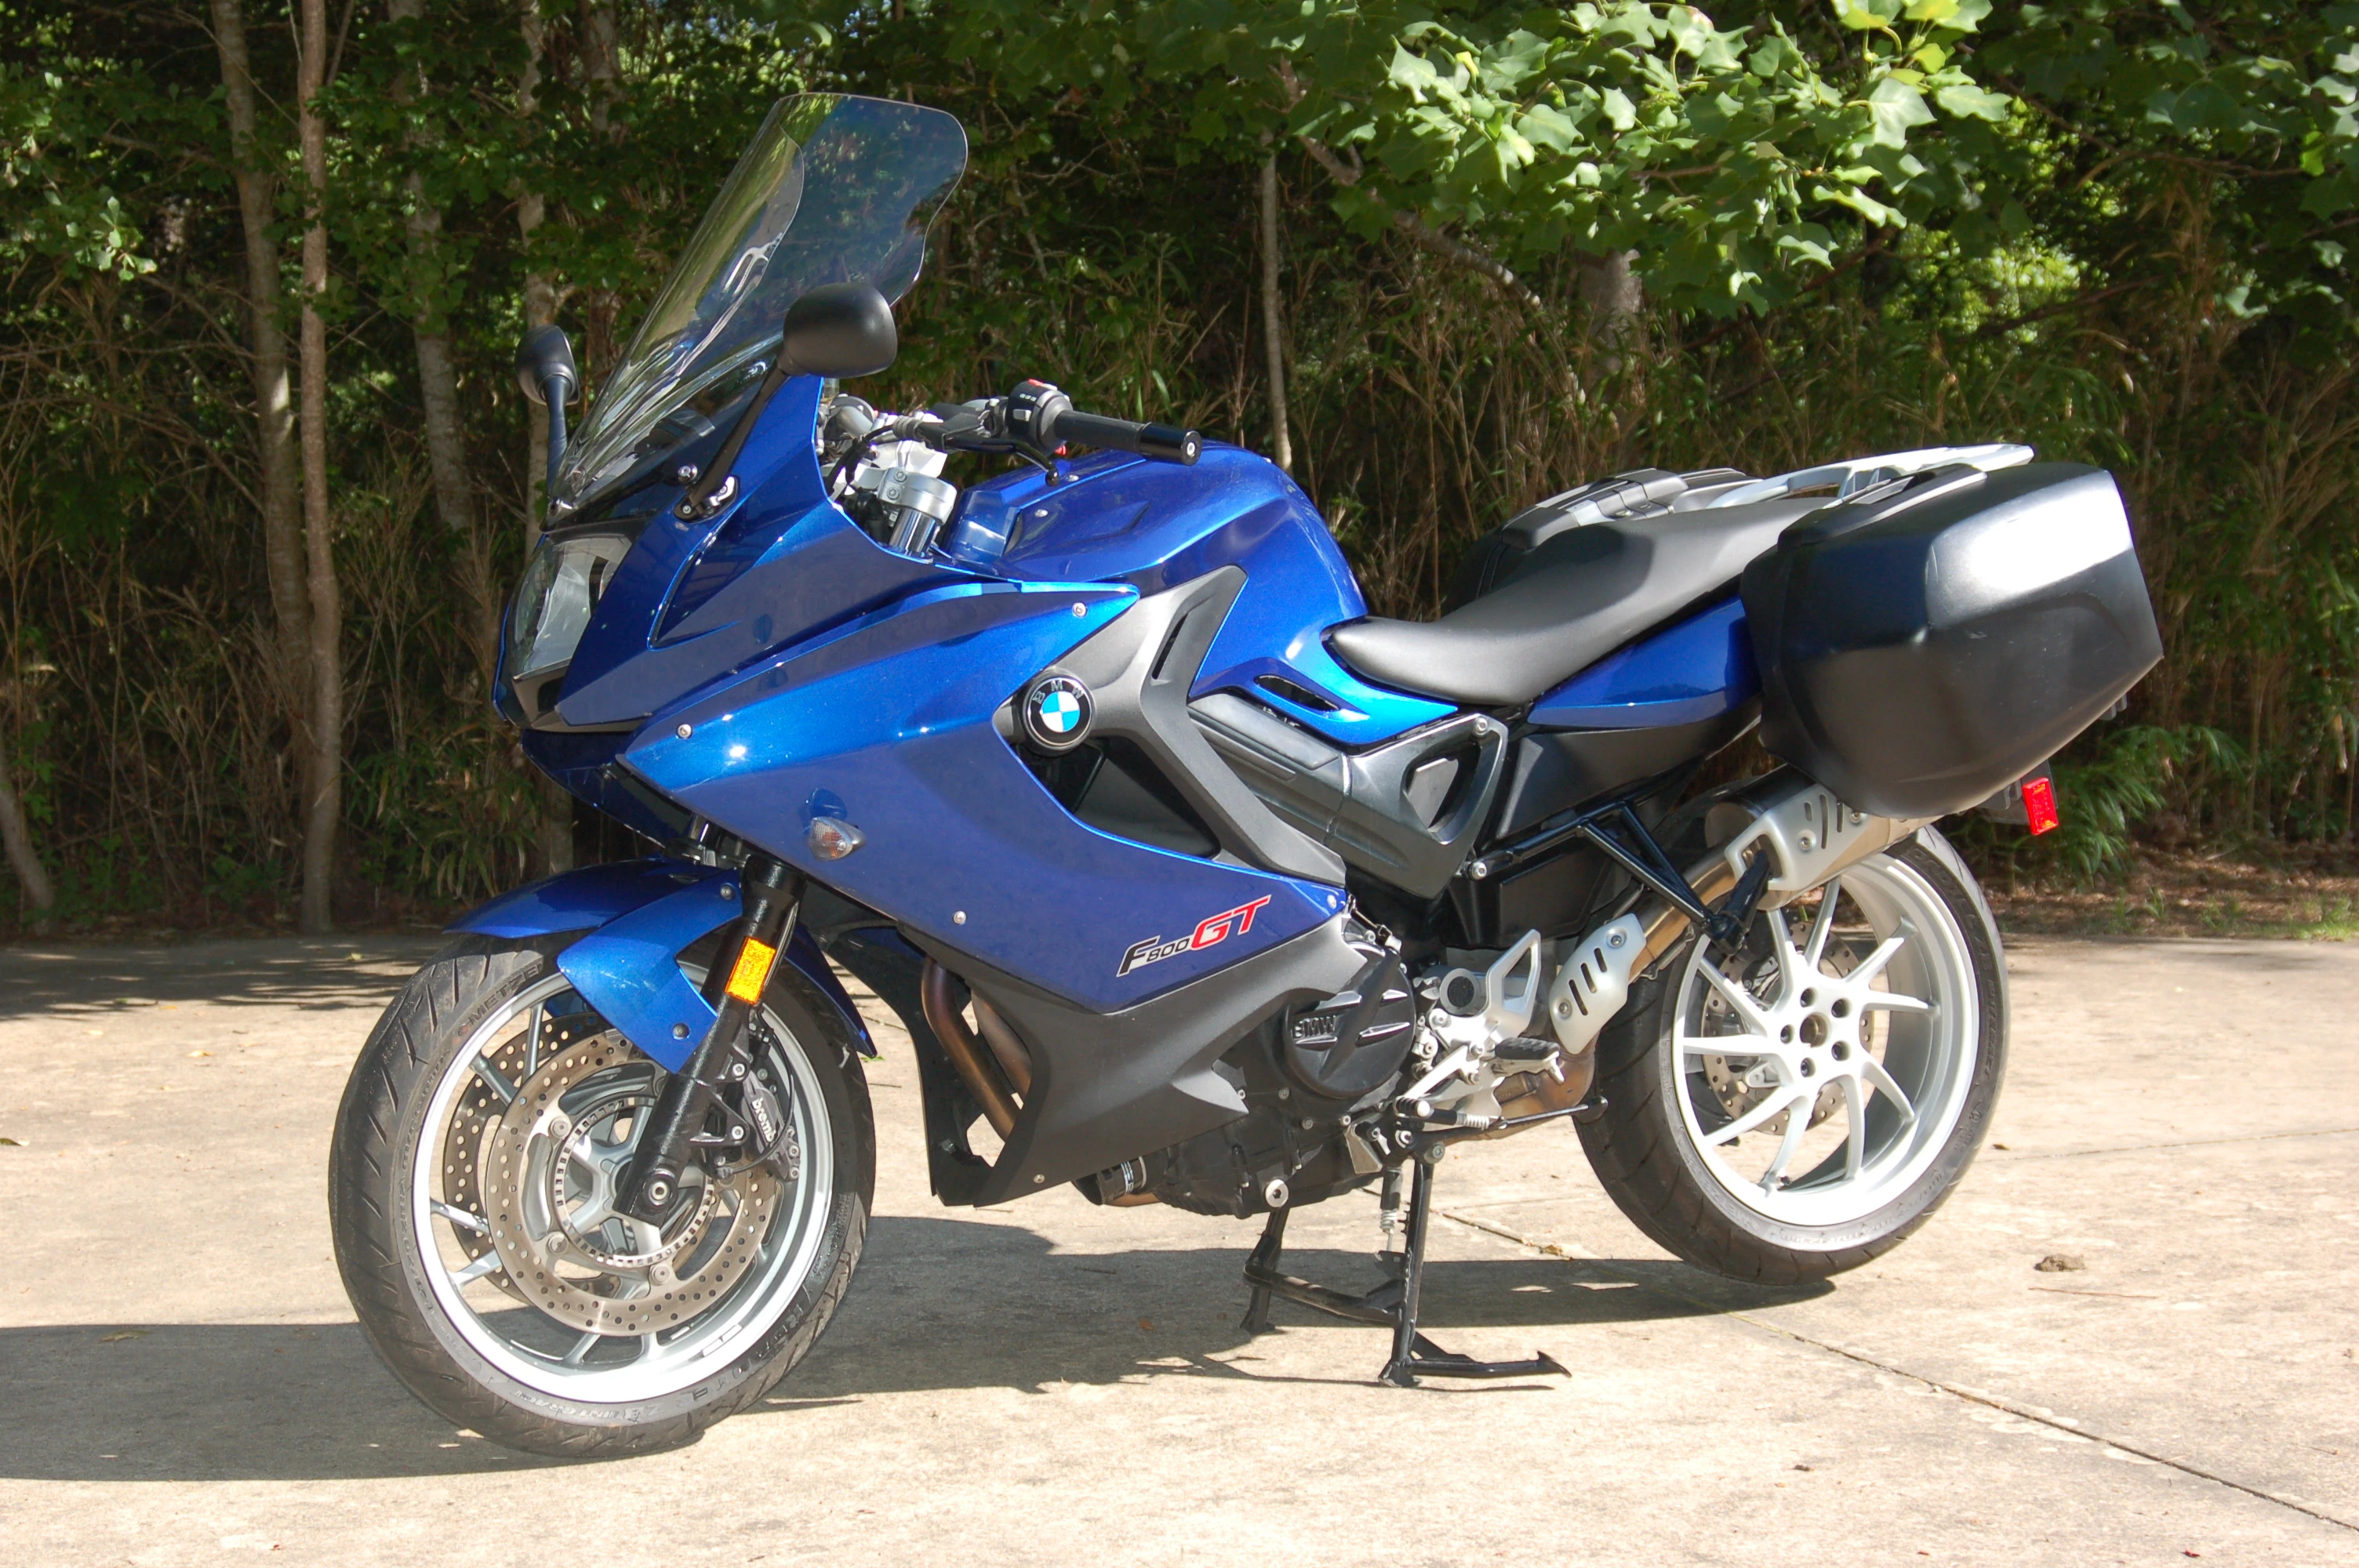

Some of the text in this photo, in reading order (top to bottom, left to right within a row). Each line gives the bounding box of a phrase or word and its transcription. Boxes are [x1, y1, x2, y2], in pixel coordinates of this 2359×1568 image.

[1032, 680, 1085, 704] BMW
[1294, 1014, 1336, 1037] BMW
[751, 1097, 776, 1145] bremb
